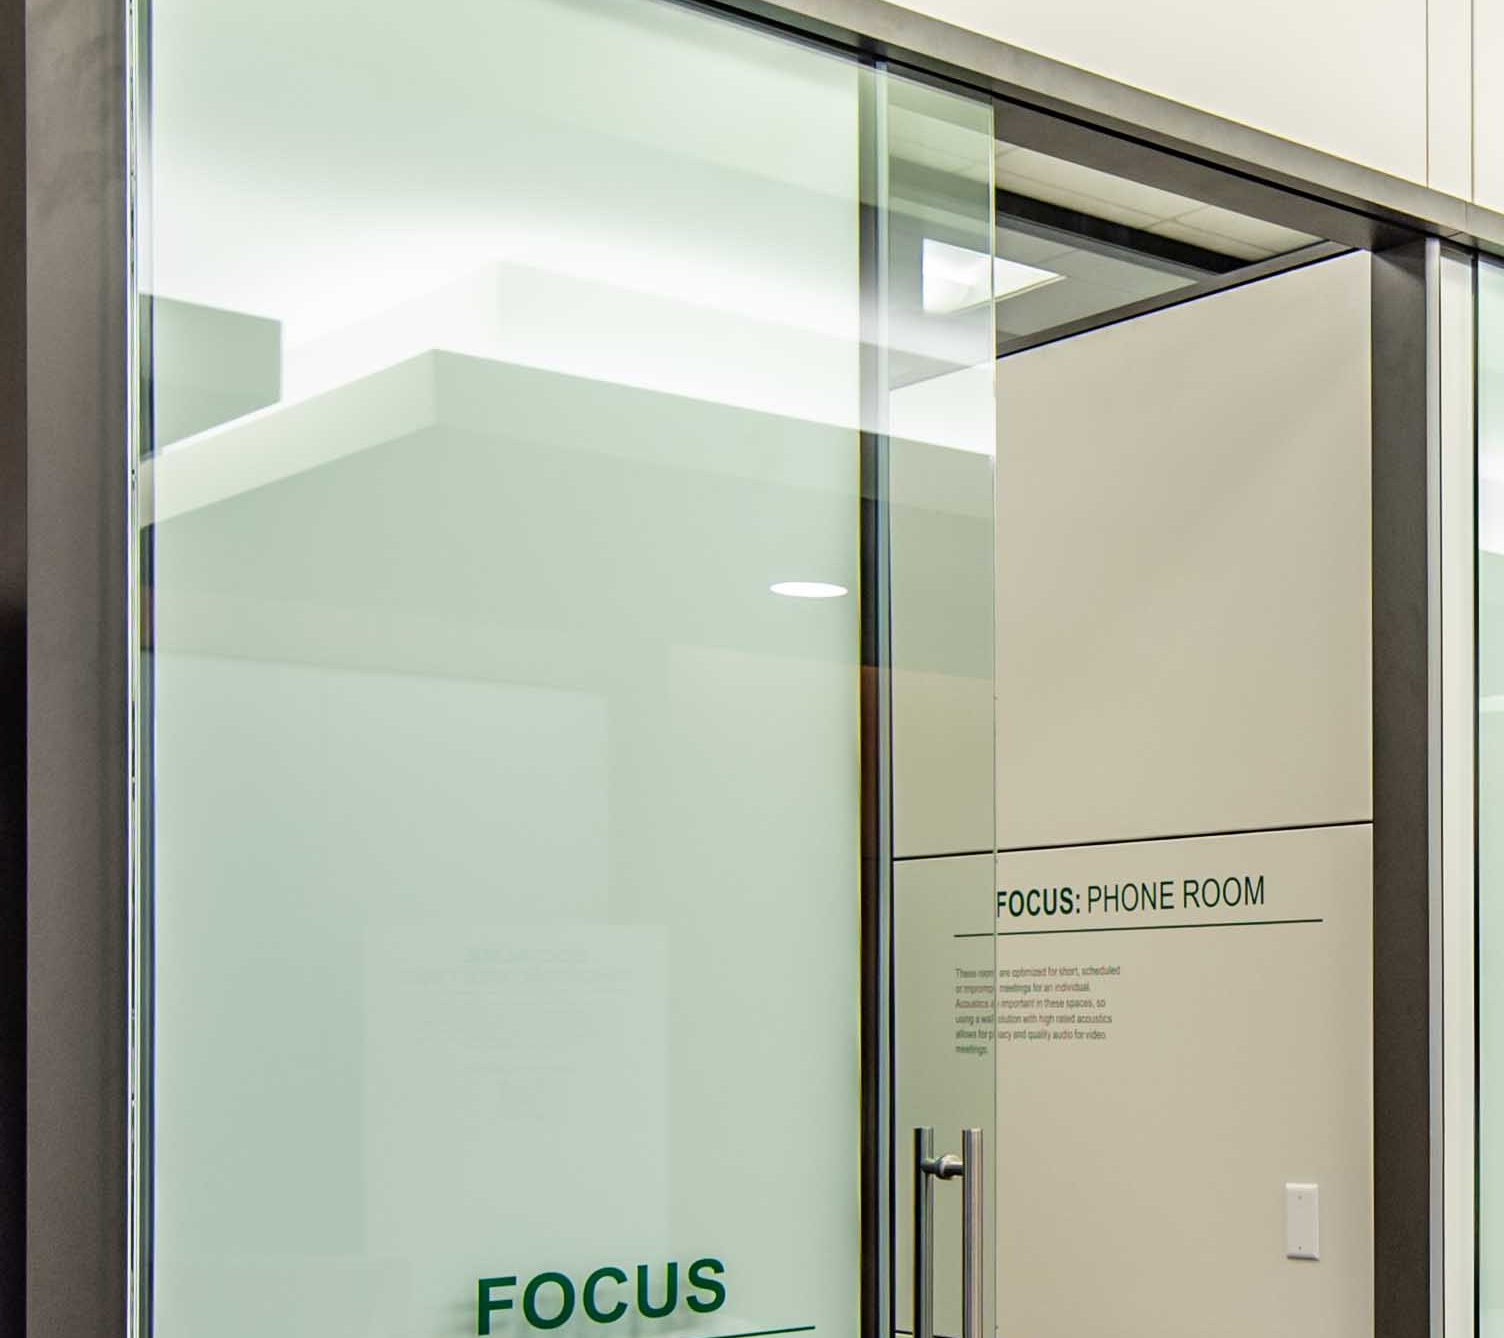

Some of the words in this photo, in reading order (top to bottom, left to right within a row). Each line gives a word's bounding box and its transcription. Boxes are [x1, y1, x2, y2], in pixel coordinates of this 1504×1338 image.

[995, 886, 1081, 919] FOCUS:
[1088, 880, 1175, 914] PHONE
[1183, 874, 1266, 909] ROOM
[474, 1257, 728, 1337] FOCUS
